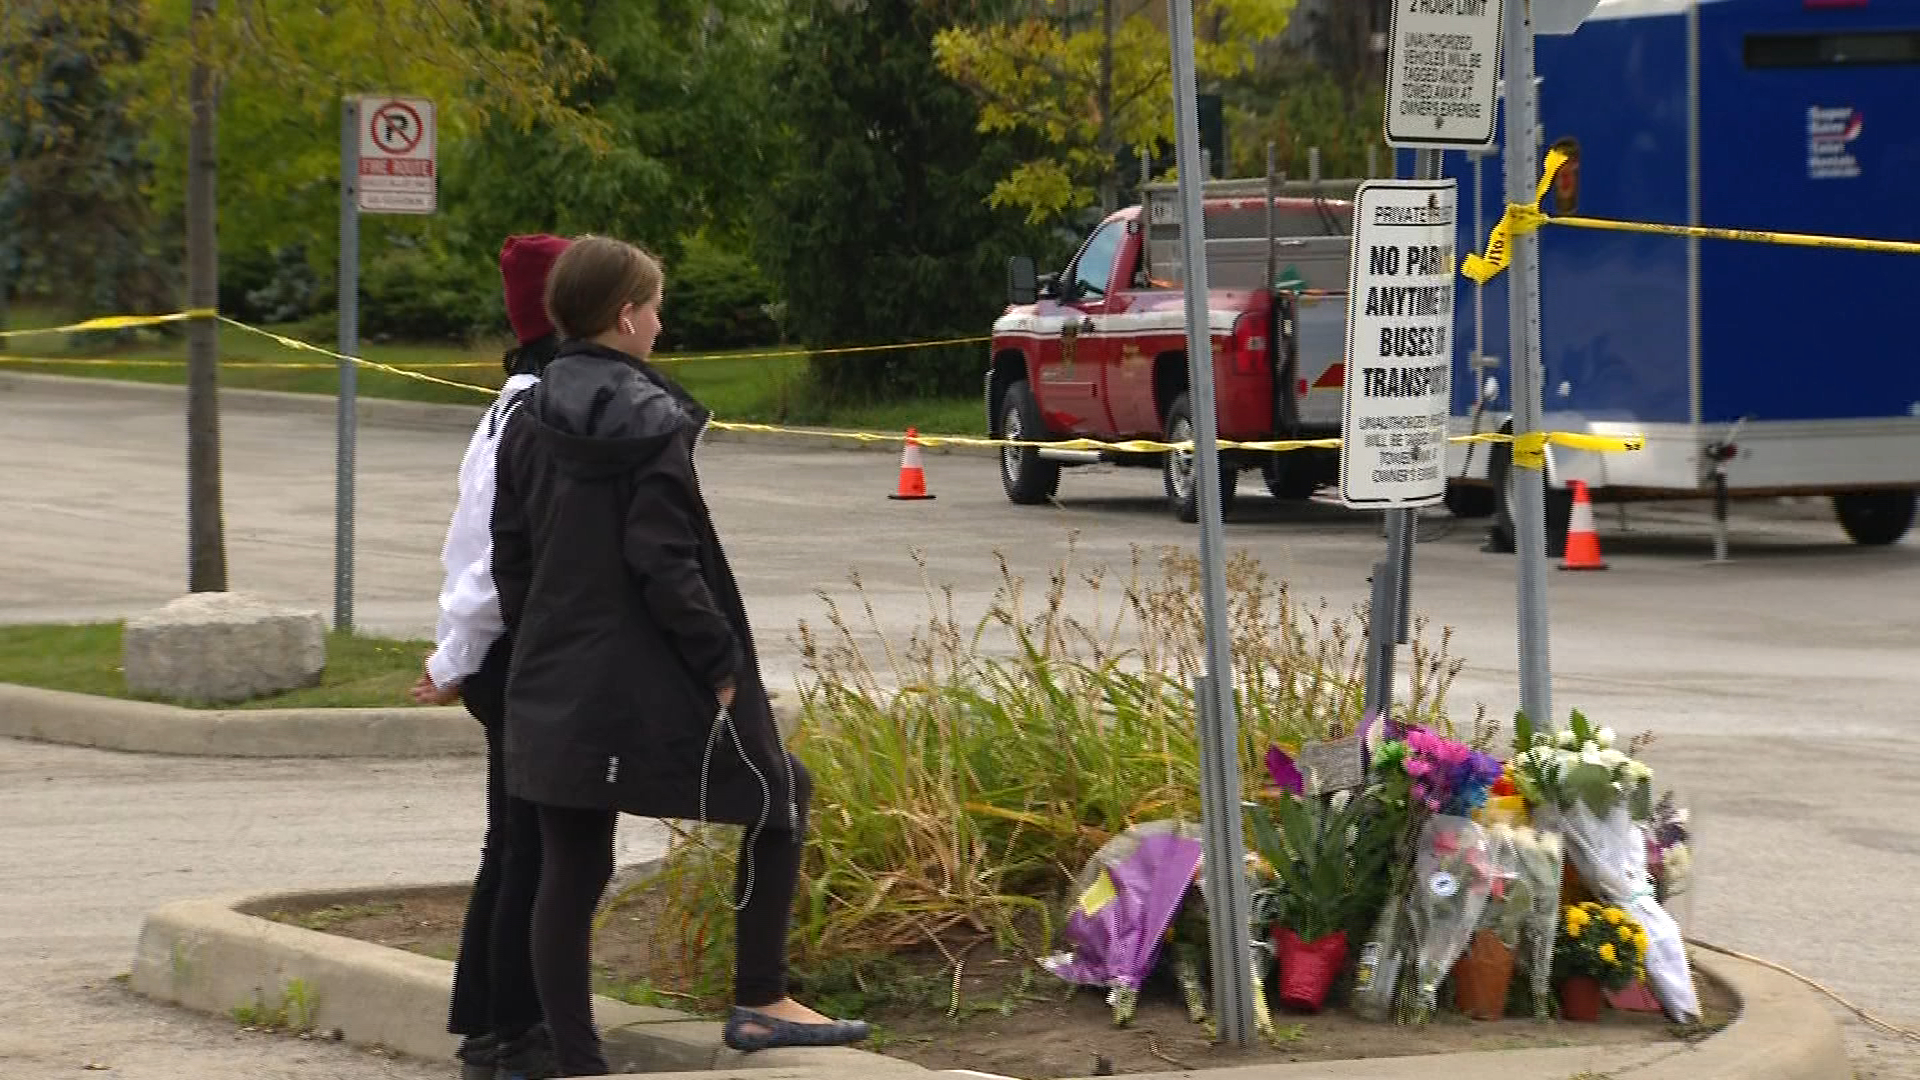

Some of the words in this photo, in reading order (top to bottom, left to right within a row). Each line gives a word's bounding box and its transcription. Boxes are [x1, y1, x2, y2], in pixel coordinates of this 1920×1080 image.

[1419, 0, 1453, 15] HOUR
[1456, 0, 1487, 16] LIMIT
[1469, 53, 1482, 68] BE
[1460, 86, 1473, 100] AT
[1375, 206, 1427, 223] PRIVATE
[1369, 245, 1400, 276] NO
[1364, 286, 1438, 316] ANYTIME
[1380, 327, 1434, 357] BUSES
